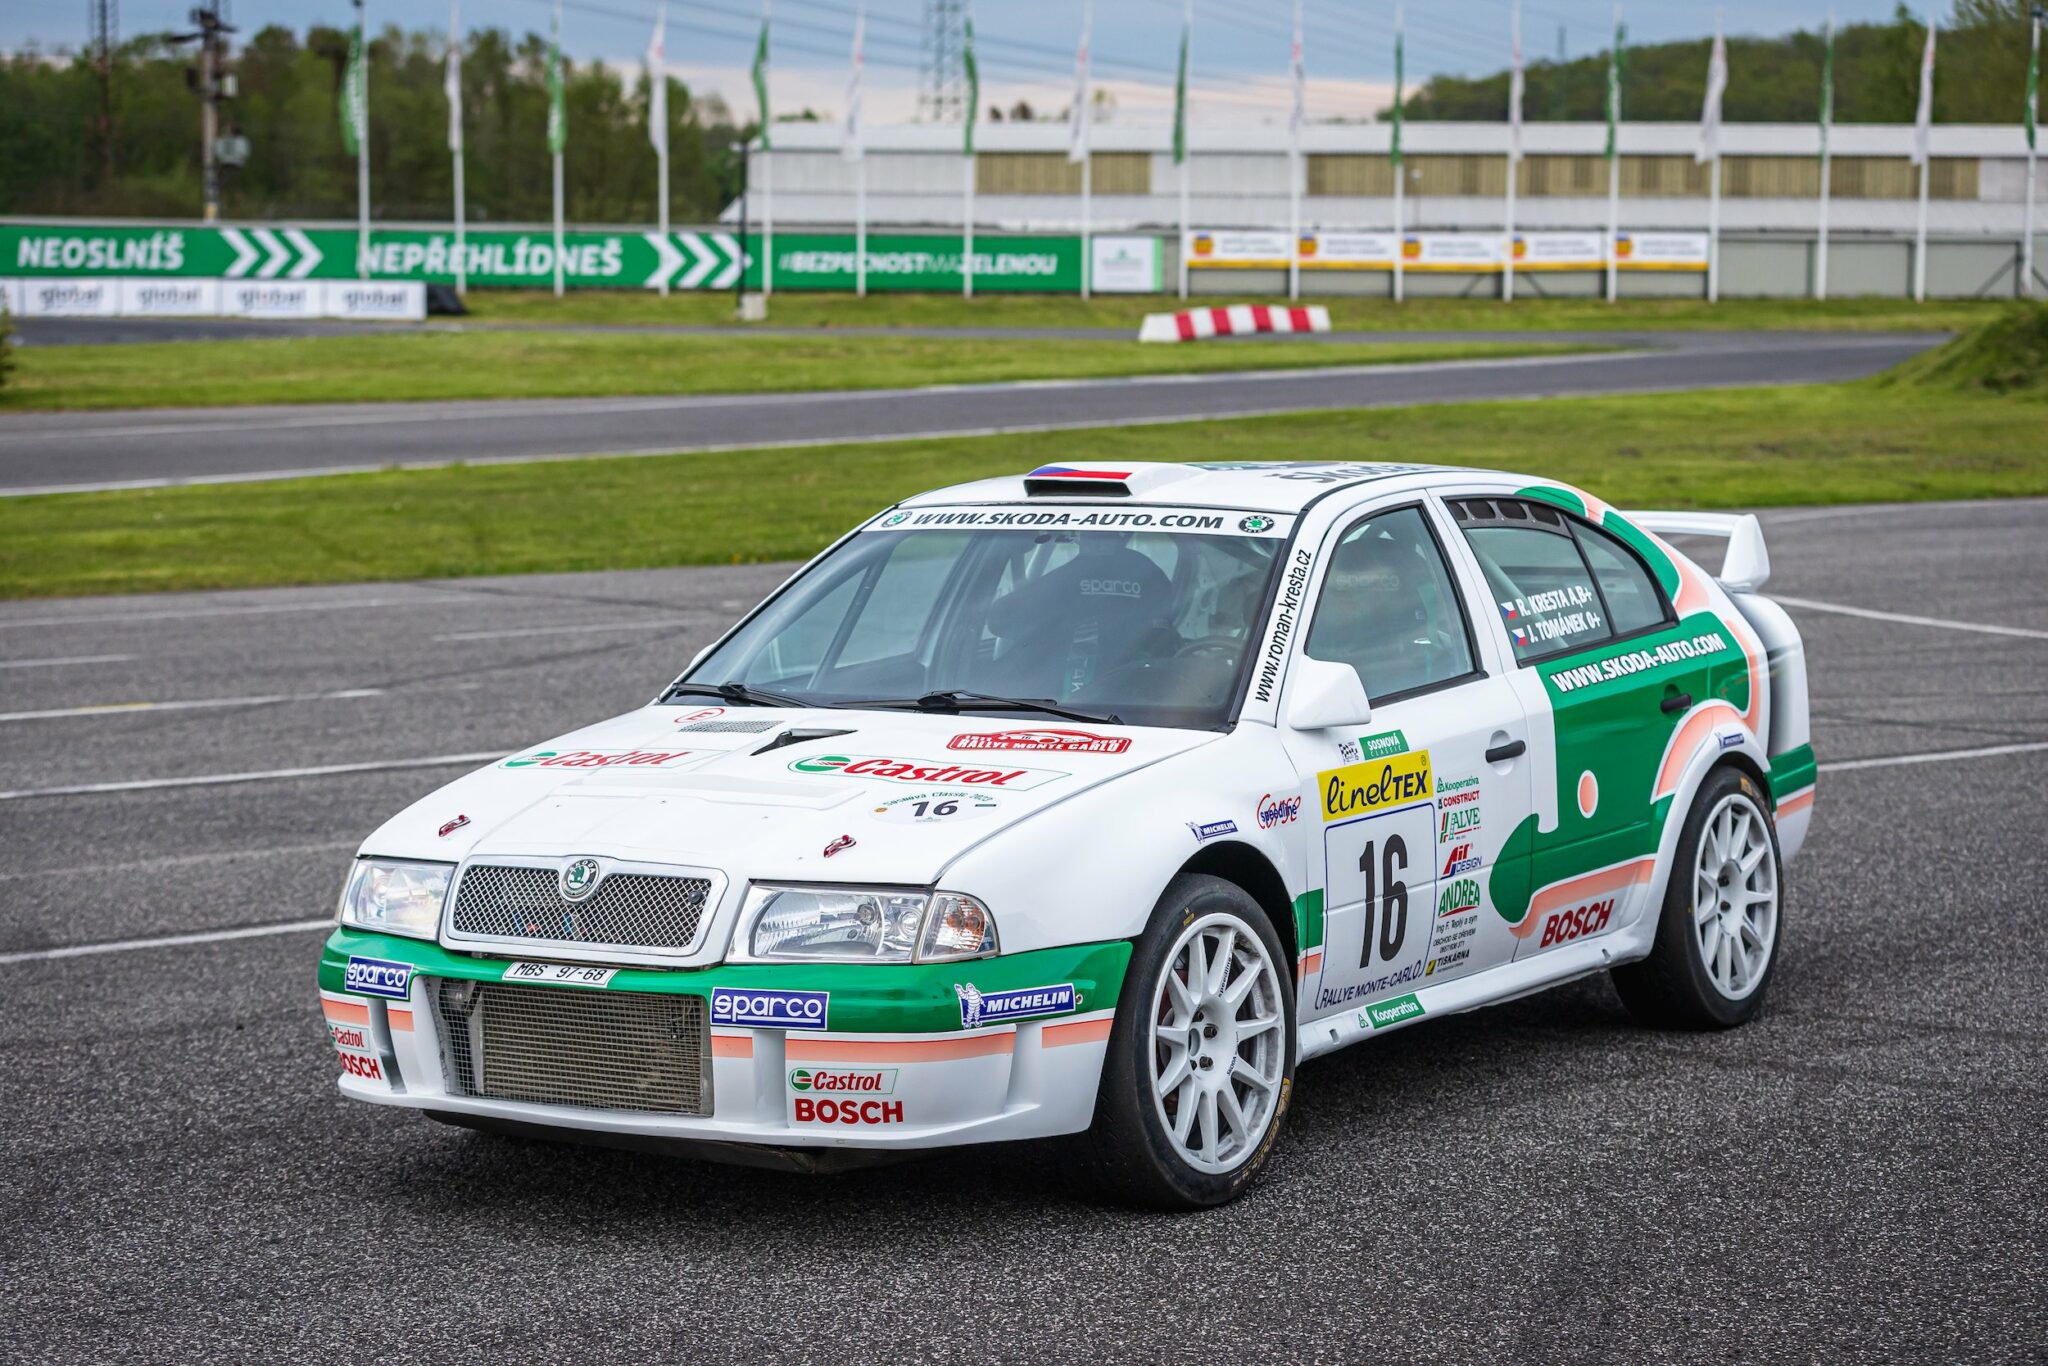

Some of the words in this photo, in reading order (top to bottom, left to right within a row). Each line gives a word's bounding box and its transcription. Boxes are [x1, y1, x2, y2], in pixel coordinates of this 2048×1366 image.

[18, 231, 184, 270] NEOSLNÍŠ
[356, 238, 623, 276] NEPŘEHLÍDNEŠ
[912, 513, 1224, 529] WWW.SKODA-AUTO.COM
[1080, 578, 1141, 594] sparco
[1515, 598, 1531, 616] R.
[1528, 587, 1570, 614] KRESTA
[1255, 549, 1312, 703] www.roman-kresta.cz
[1526, 624, 1538, 643] J.
[1535, 612, 1588, 640] TOMÁNEK
[1550, 632, 1727, 693] WWW.SKODA-AUTO.COM
[957, 737, 1008, 750] RALLYE
[1068, 740, 1121, 752] CARLO
[1367, 732, 1400, 751] SOSNOVÁ
[1370, 746, 1402, 757] CLASSIC
[540, 751, 693, 767] Castrol
[843, 758, 1028, 786] Castrol
[1445, 776, 1480, 791] Kooperativa
[912, 800, 959, 817] 16
[1443, 790, 1480, 808] CONSTRUCT
[1203, 822, 1235, 835] MICHELIN
[1359, 833, 1408, 969] 16
[1438, 879, 1480, 917] ANDREA
[1540, 898, 1615, 949] BOSCH
[347, 962, 408, 989] sparco
[513, 963, 546, 978] MBS
[556, 967, 608, 982] 97-68
[1320, 987, 1355, 1009] RALLYE
[1355, 960, 1421, 998] MONTE-CARLO
[714, 993, 823, 1023] sparco
[986, 990, 1070, 1013] MICHELIN
[1372, 1001, 1419, 1022] Kooperativa
[334, 1026, 365, 1048] Castrol
[336, 1049, 382, 1080] OSCH
[813, 1071, 882, 1092] Castrol
[794, 1099, 904, 1125] BOSCH
